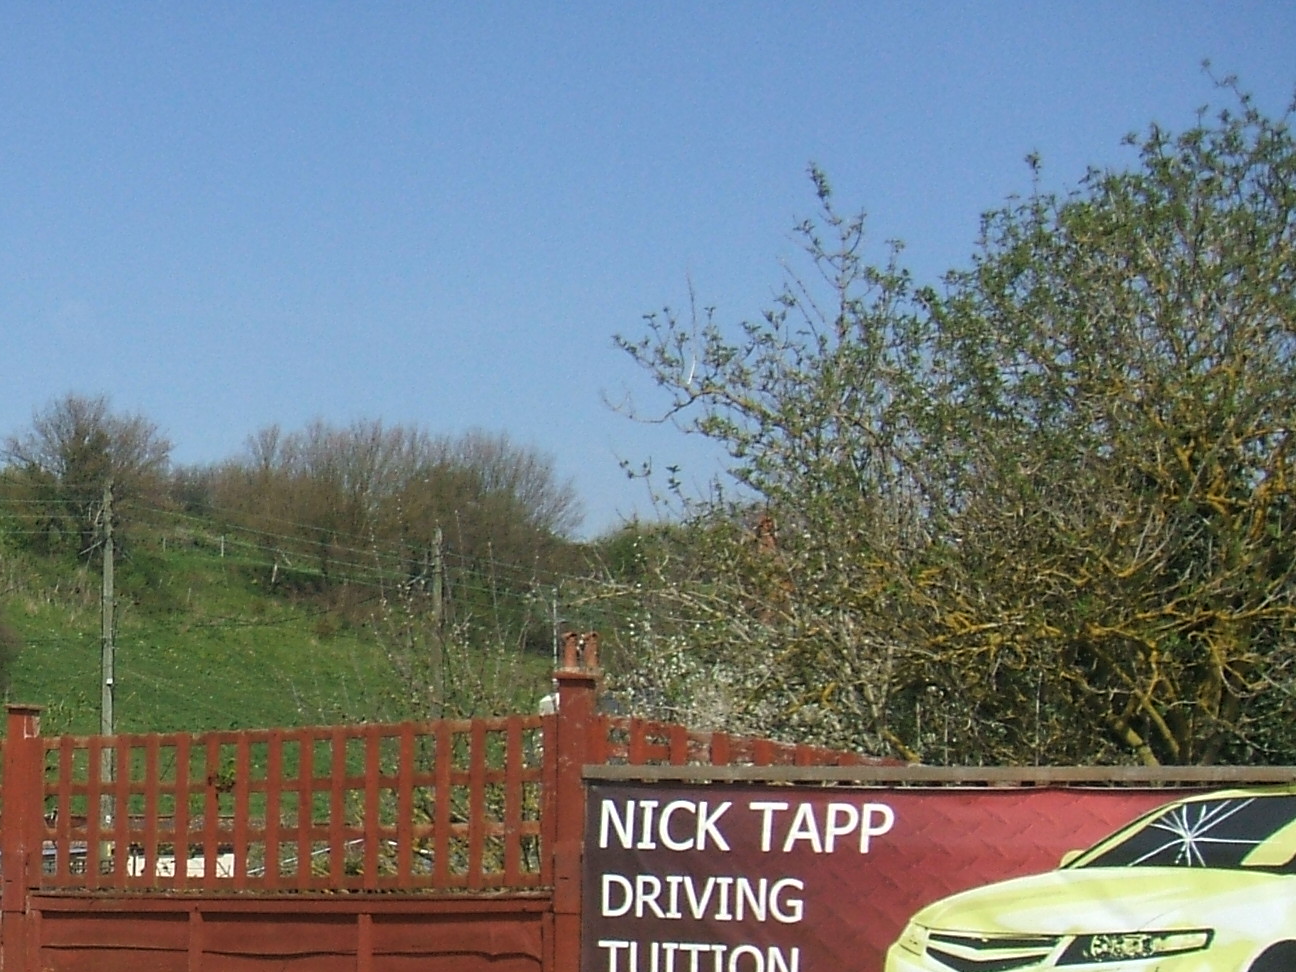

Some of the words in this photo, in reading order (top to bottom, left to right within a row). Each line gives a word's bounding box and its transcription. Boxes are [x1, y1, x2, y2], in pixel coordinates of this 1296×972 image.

[599, 799, 732, 851] NICK
[749, 802, 895, 854] TAPP
[602, 874, 804, 923] DRIVING
